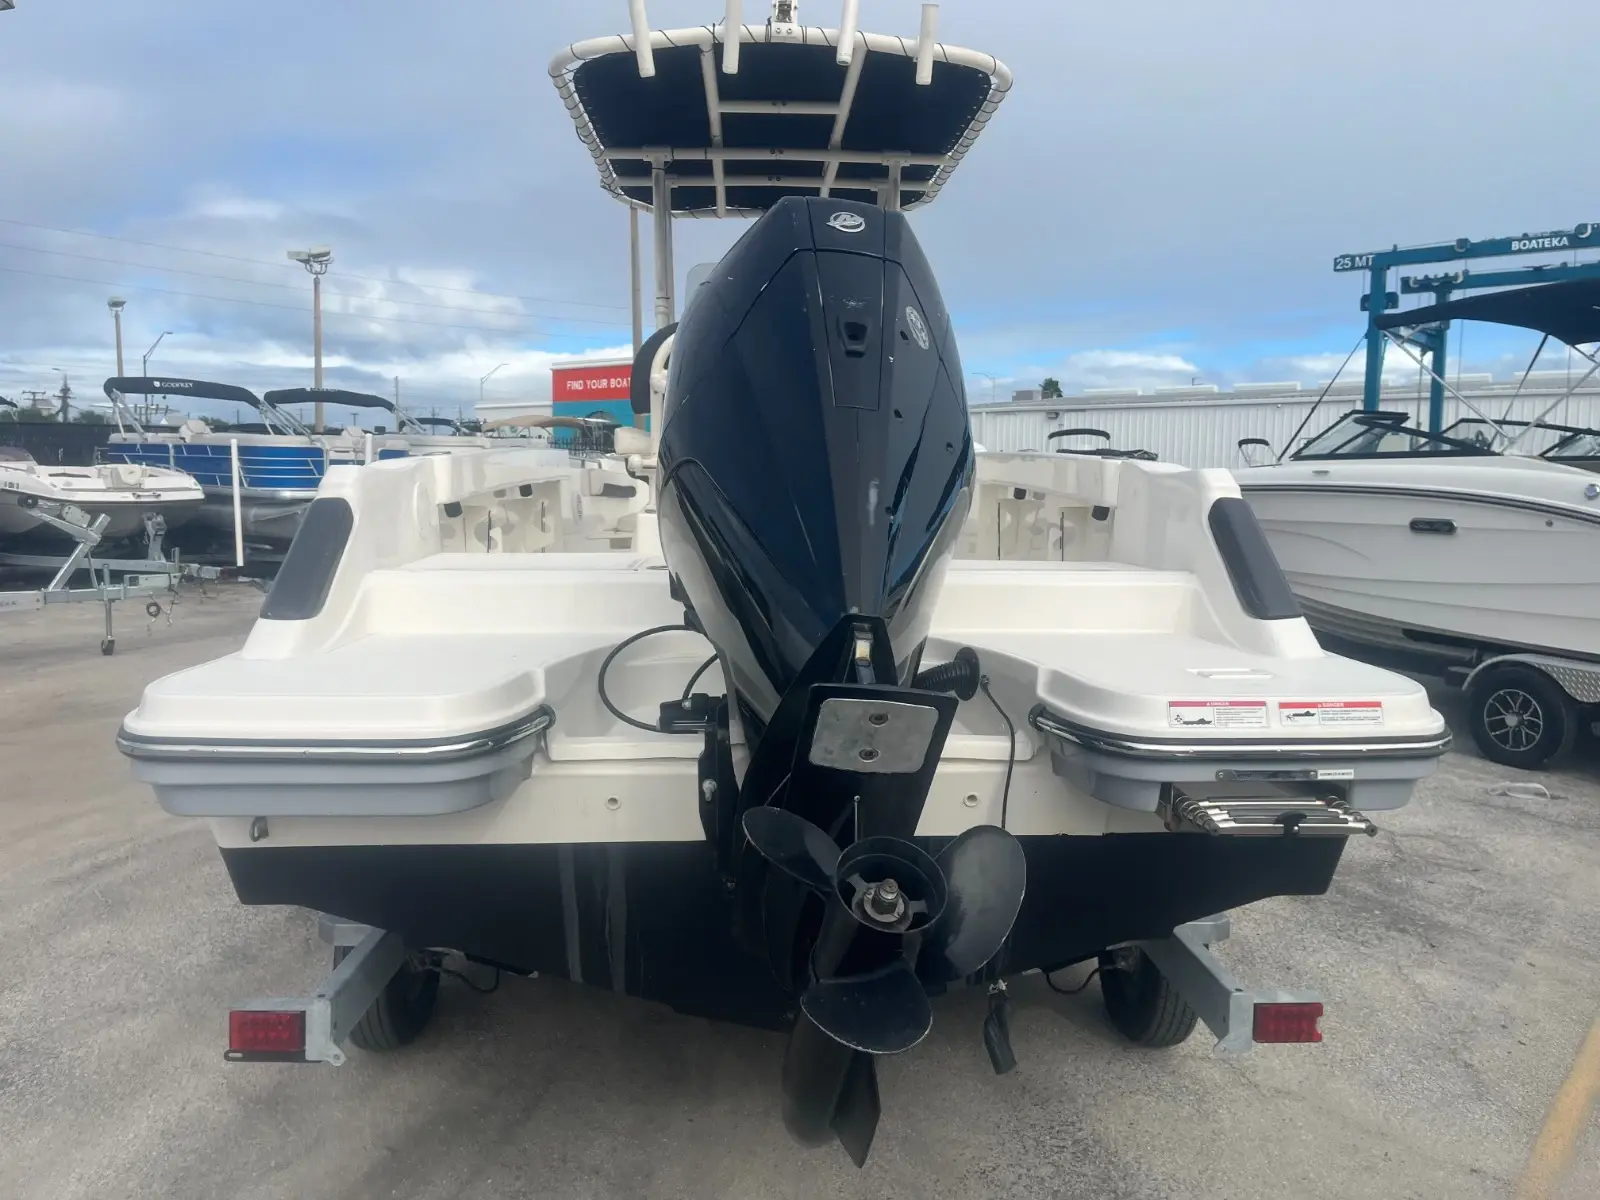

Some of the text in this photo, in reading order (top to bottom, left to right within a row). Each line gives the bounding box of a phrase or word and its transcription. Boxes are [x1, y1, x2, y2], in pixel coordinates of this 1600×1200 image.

[1511, 236, 1569, 251] BOATEKA
[1335, 254, 1375, 270] 25 MT
[566, 380, 584, 390] FIND
[586, 378, 608, 389] YOUR
